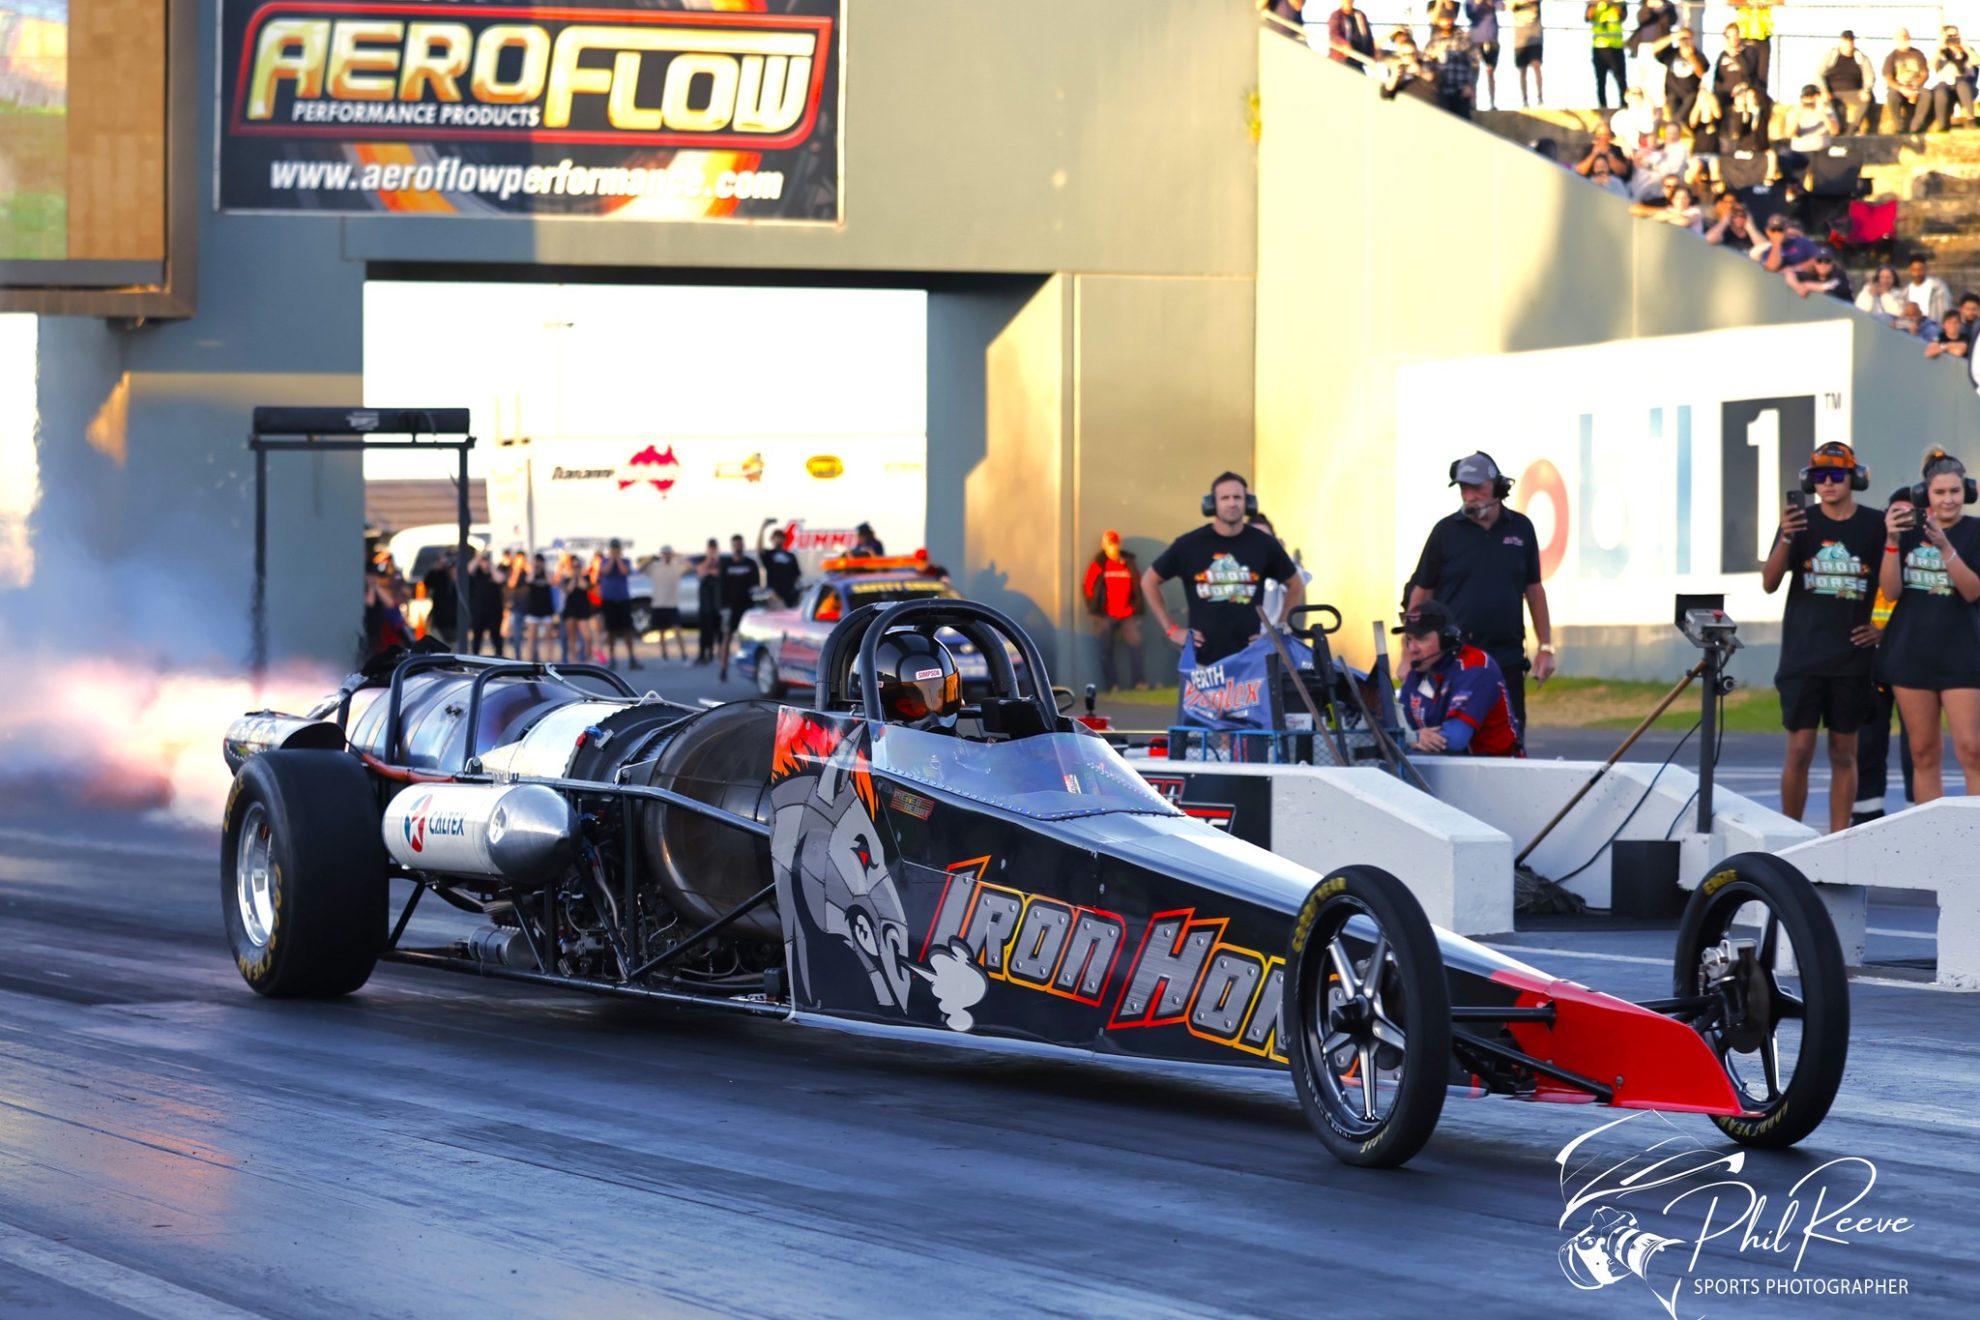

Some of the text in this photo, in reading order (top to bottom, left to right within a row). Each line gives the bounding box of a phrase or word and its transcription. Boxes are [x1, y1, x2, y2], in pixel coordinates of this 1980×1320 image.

[247, 18, 816, 132] AEROFLOW
[292, 101, 541, 127] PERFORMANCE PRODUCTS
[1825, 393, 1842, 410] TM
[784, 518, 859, 551] SUMMI
[1191, 665, 1225, 690] PERTH
[429, 811, 465, 836] CALTEX
